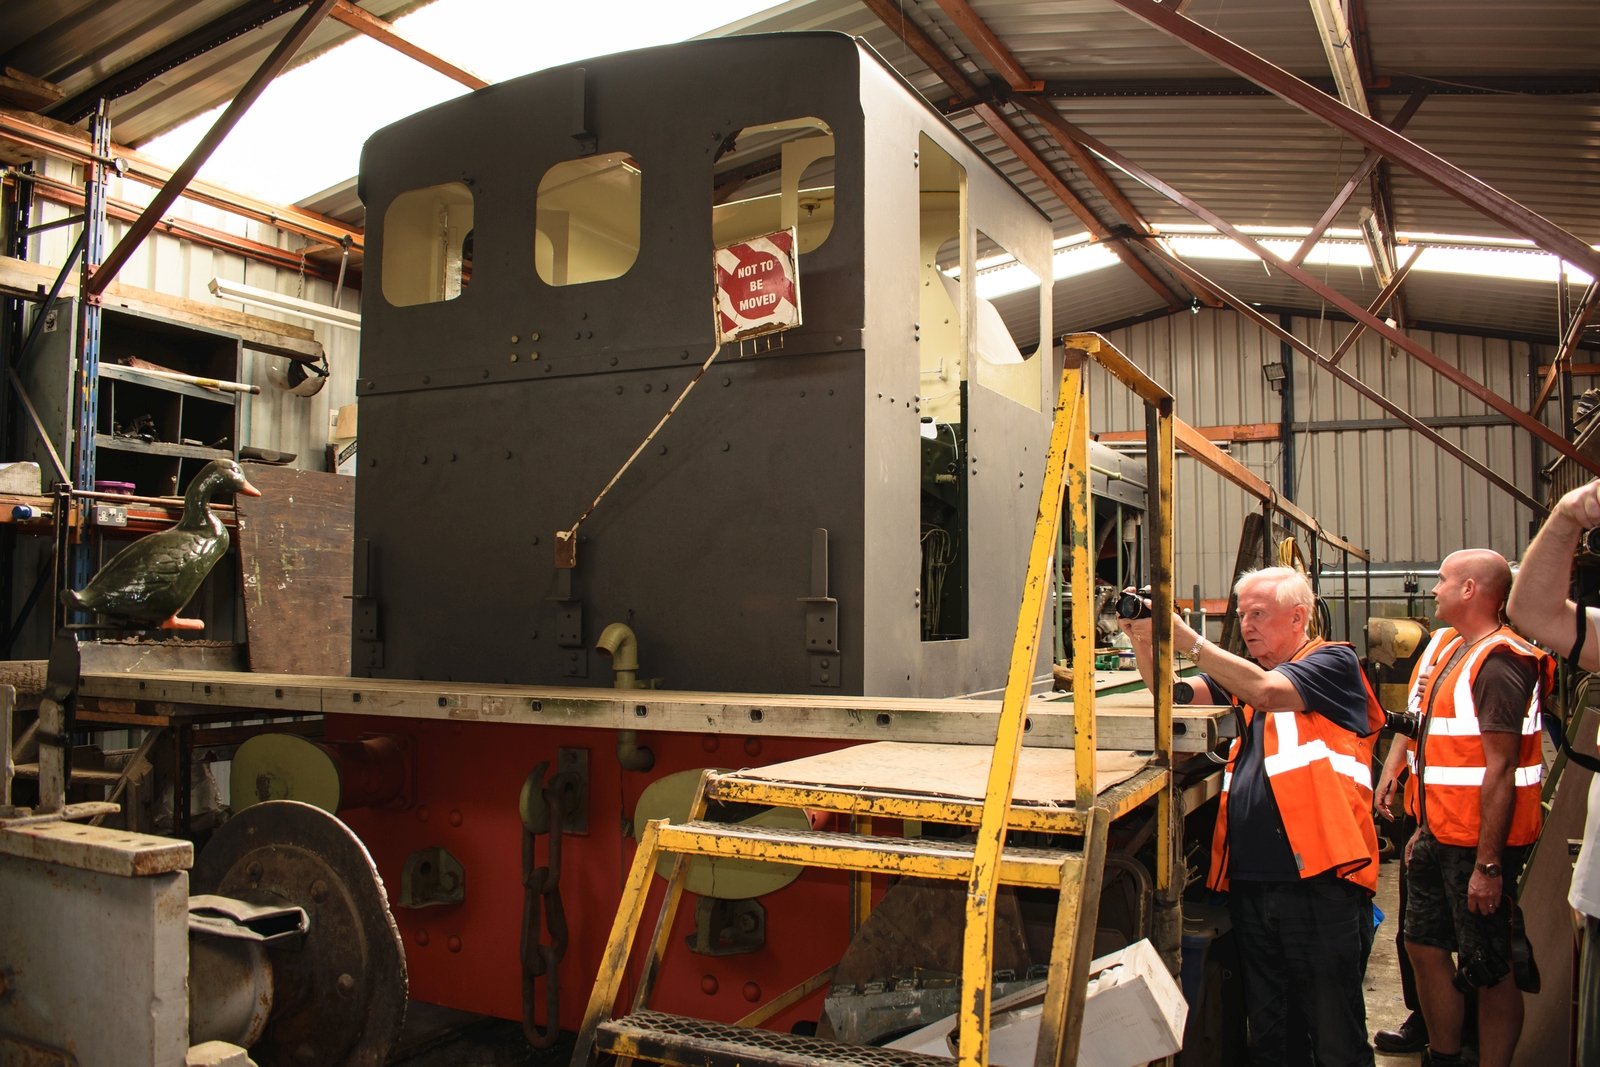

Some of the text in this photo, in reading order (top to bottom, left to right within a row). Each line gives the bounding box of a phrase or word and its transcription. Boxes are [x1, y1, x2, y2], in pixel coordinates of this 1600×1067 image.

[738, 260, 774, 278] NOT TO
[750, 279, 763, 291] BE
[740, 293, 776, 311] MOVED
